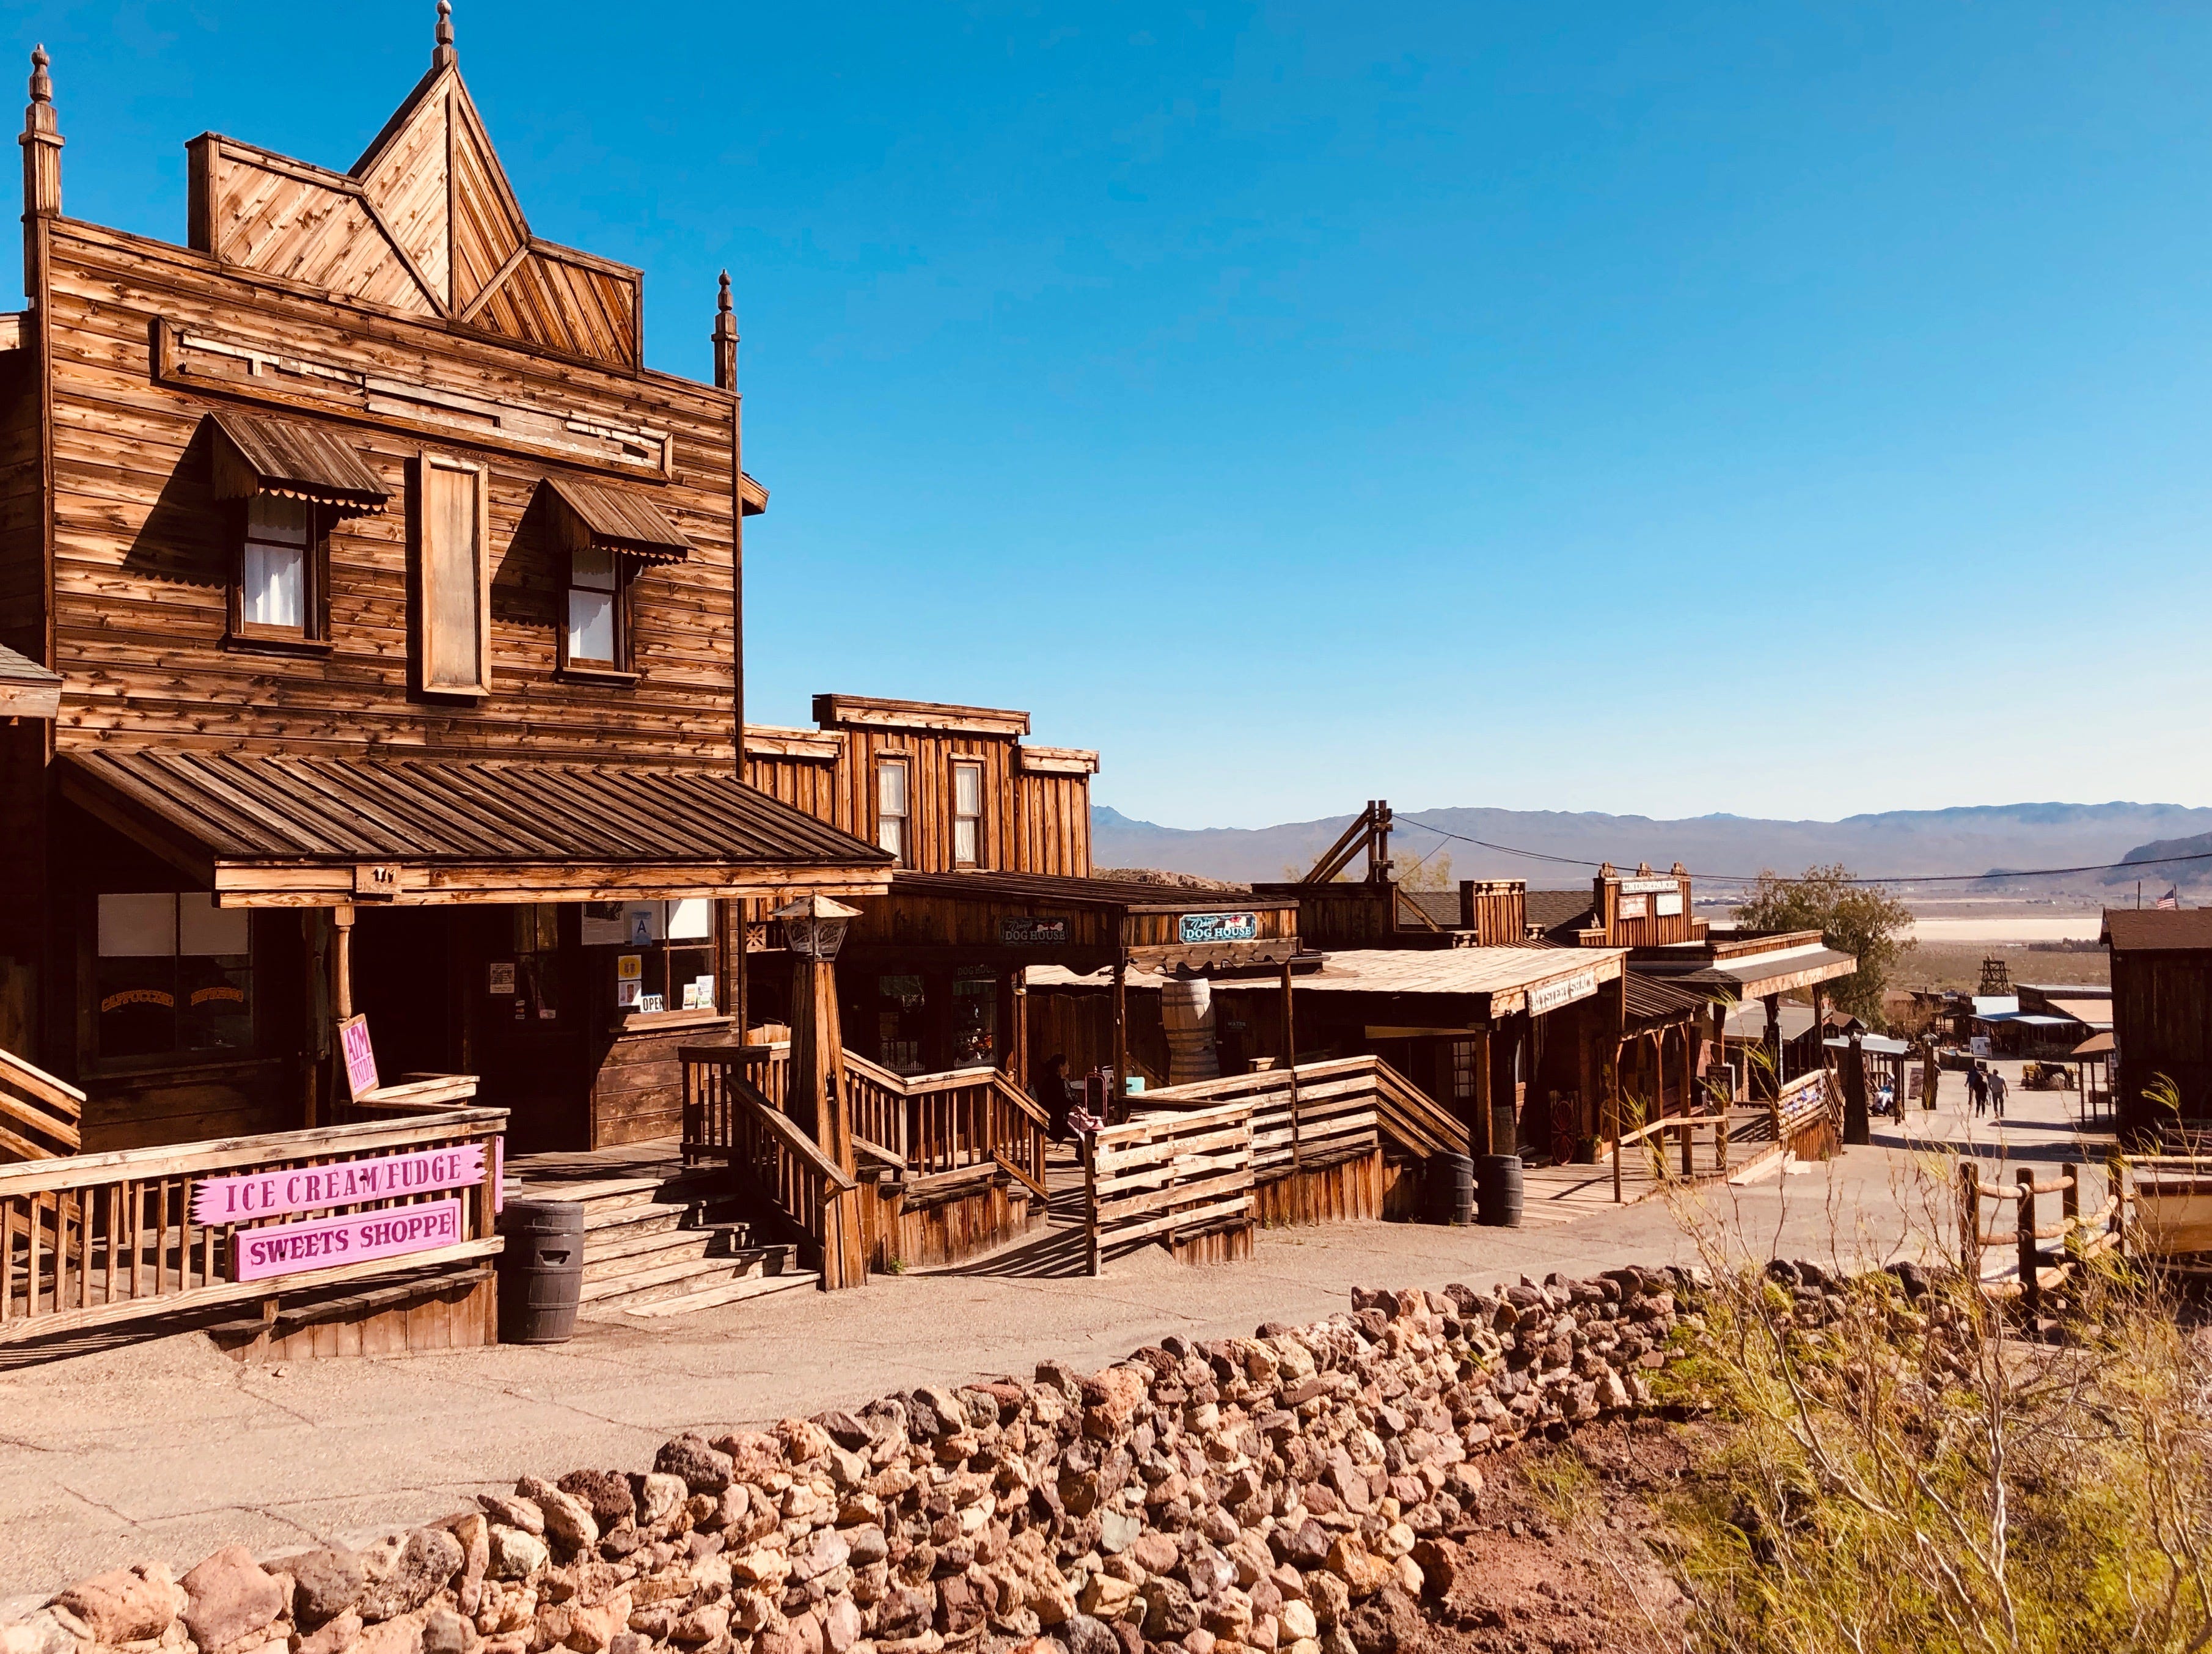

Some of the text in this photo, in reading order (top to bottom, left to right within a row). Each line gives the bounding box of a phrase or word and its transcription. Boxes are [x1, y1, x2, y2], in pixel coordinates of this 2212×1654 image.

[1622, 880, 1679, 891] UNDERTAKER
[637, 920, 647, 934] A
[1005, 931, 1066, 940] DOG HOUSE
[1186, 927, 1251, 939] DOG HOUSE
[958, 966, 973, 976] DOG
[1531, 970, 1596, 1012] MYSTERY SHACK
[642, 994, 664, 1011] OPEN
[346, 1021, 371, 1064] ATM
[351, 1056, 374, 1088] INSIDE
[225, 1180, 275, 1213] ICE
[251, 1212, 452, 1267] SWEETS SHOPPE
